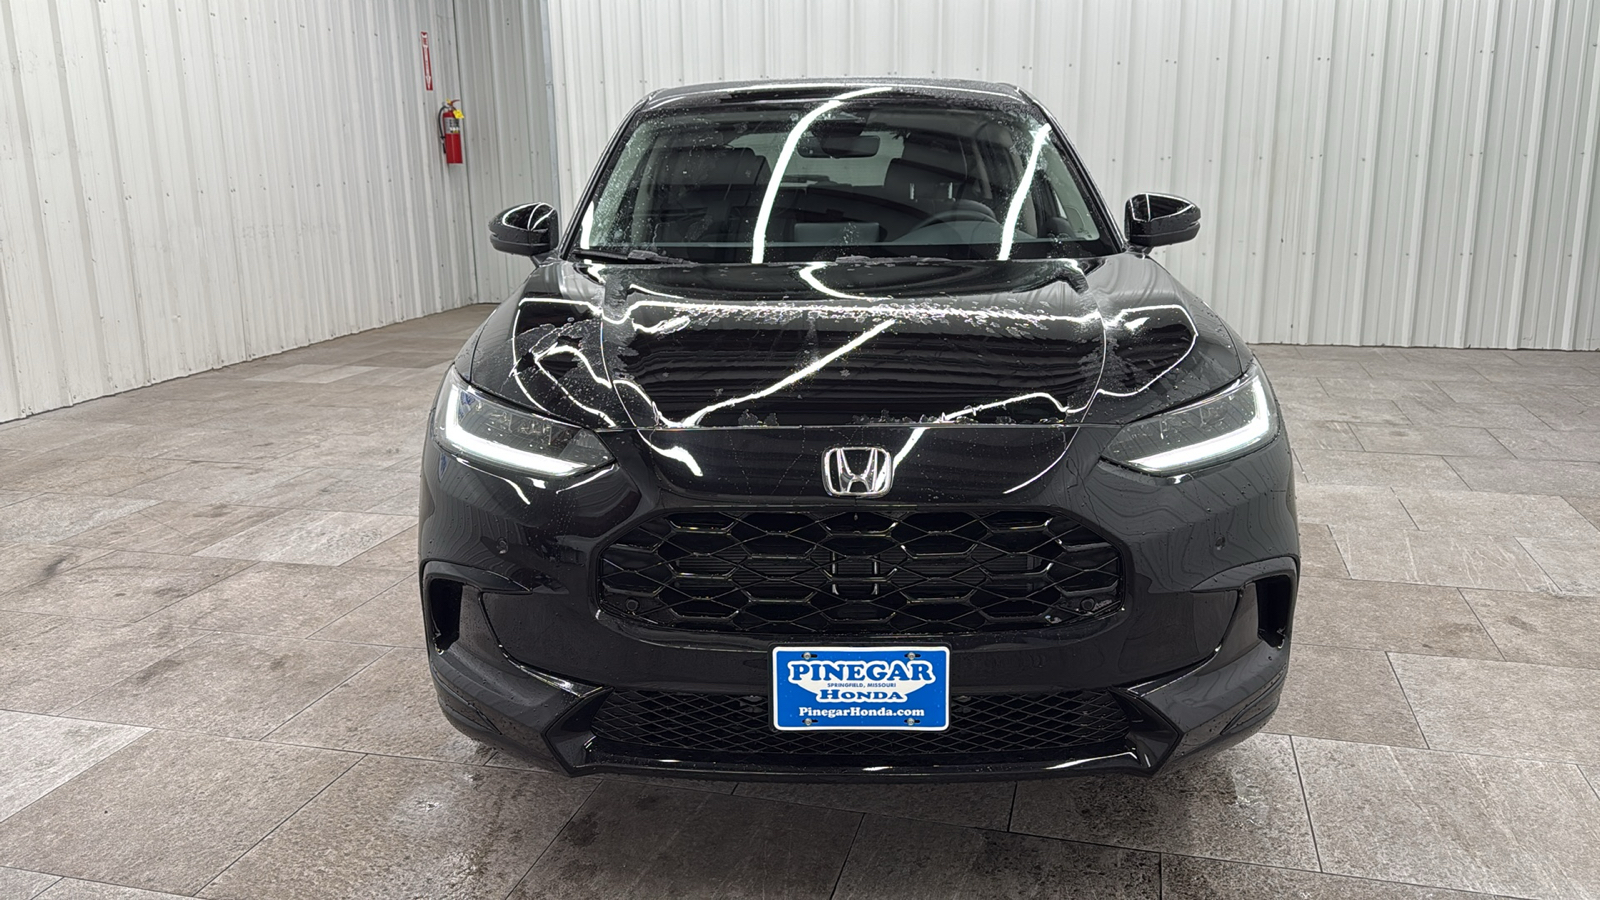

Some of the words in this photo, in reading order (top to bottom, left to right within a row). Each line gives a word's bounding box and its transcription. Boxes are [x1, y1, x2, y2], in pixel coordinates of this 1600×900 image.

[791, 663, 933, 682] PINEGAR
[819, 689, 904, 700] HONDA
[798, 706, 925, 718] PinegarHonda.com
